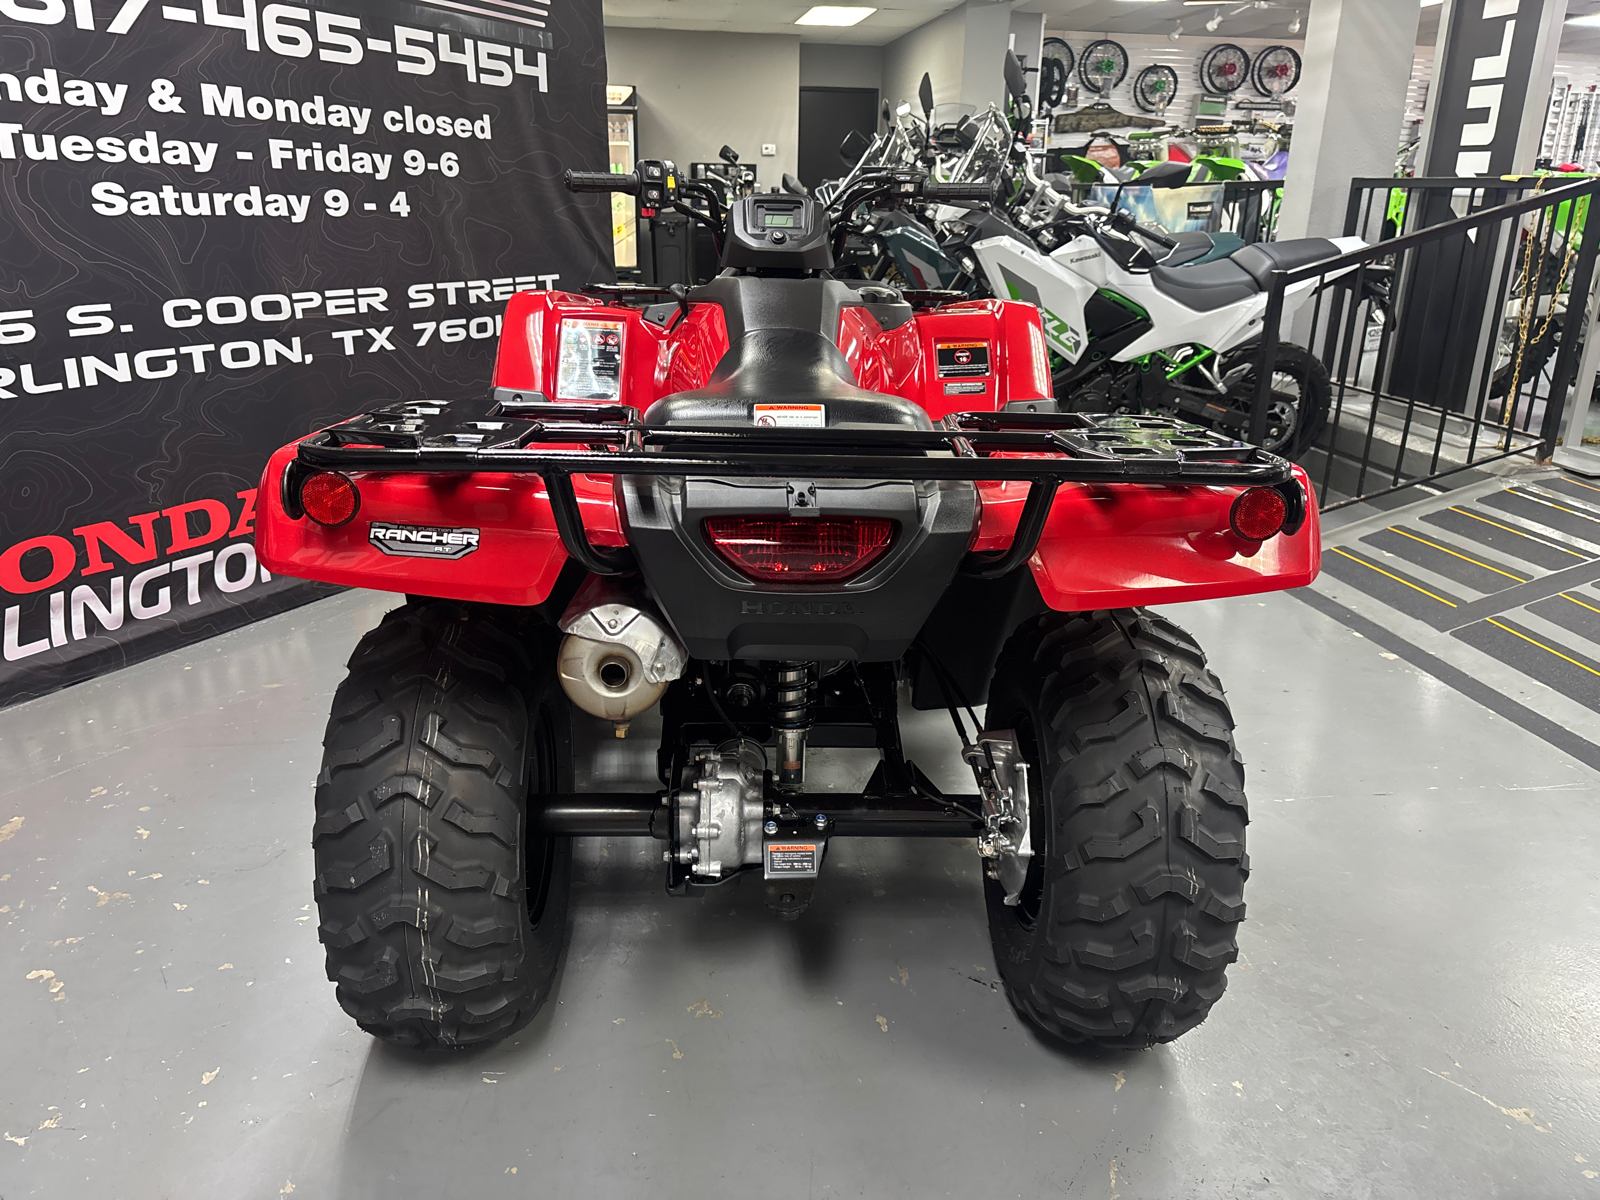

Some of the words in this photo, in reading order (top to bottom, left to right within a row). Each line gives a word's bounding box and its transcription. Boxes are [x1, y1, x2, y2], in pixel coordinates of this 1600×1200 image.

[148, 78, 187, 114] &
[200, 82, 371, 135] Monday
[383, 105, 492, 140] closed
[0, 122, 218, 172] Tuesday
[236, 150, 254, 160] -
[268, 138, 393, 180] Friday
[402, 149, 460, 178] 9-6
[91, 181, 311, 223] Saturday
[323, 188, 350, 218] 9
[363, 202, 377, 211] -
[389, 191, 411, 217] 4
[66, 303, 134, 338] S.
[162, 286, 390, 328] COOPER
[407, 273, 560, 309] STREET
[331, 325, 397, 356] TX
[369, 528, 479, 545] RANCHER
[740, 600, 864, 614] HONDA
